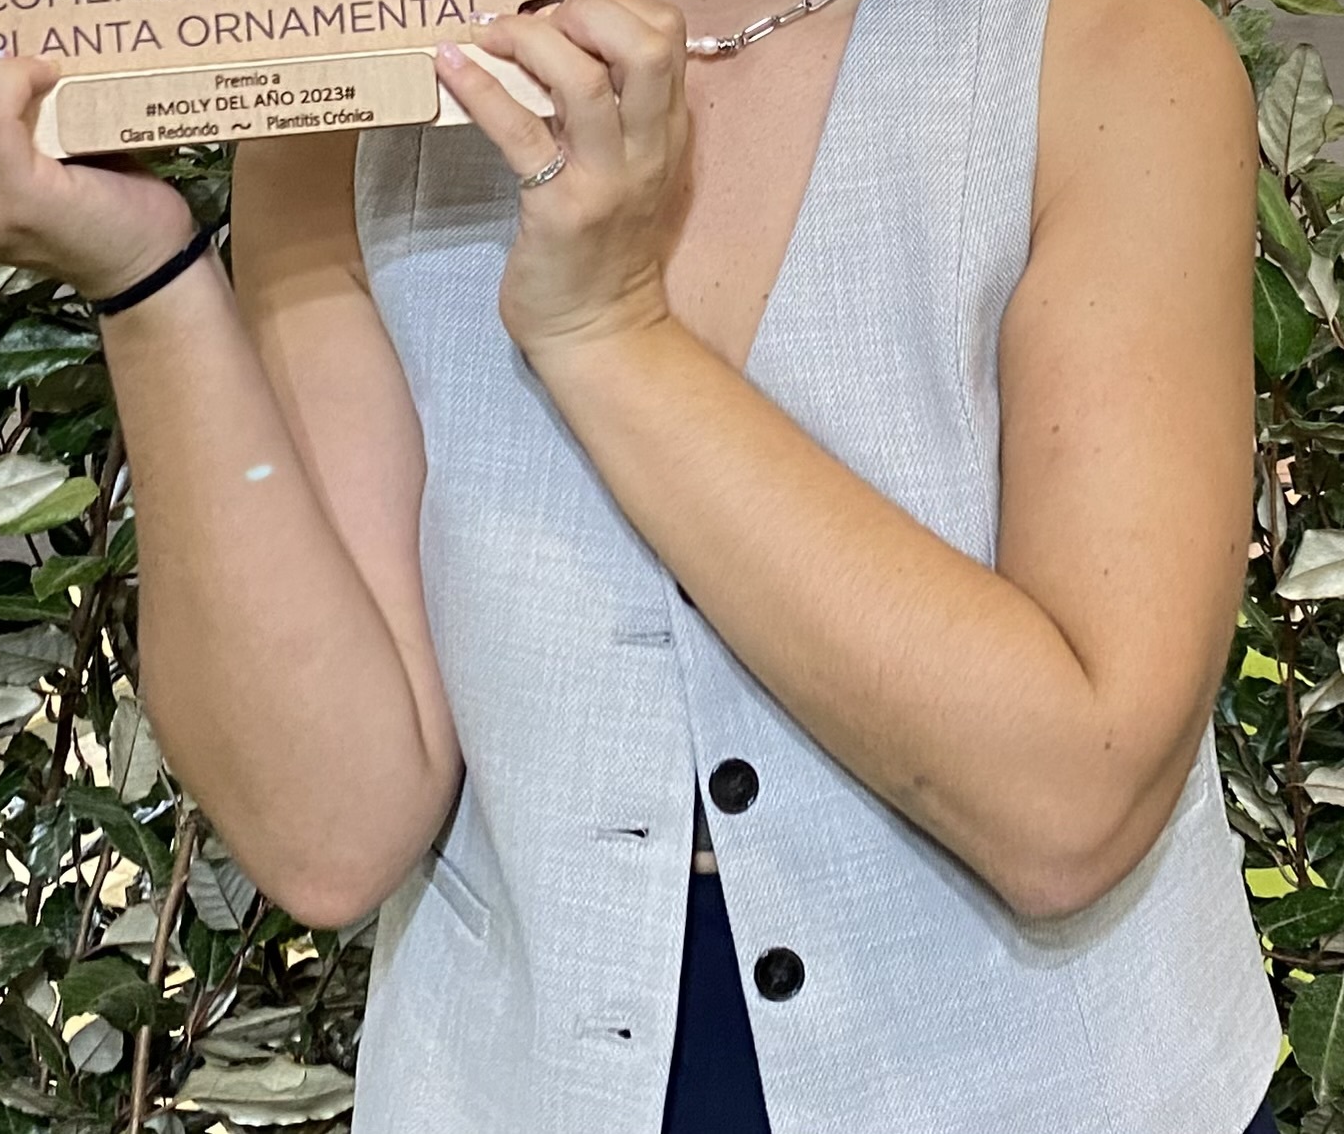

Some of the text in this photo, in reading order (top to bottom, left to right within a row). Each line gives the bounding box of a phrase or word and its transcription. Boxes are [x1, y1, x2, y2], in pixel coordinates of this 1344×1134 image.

[215, 72, 281, 90] Premio a
[146, 85, 355, 117] #MOLY DEL AÑO 2023#
[120, 128, 154, 143] Clara
[158, 122, 219, 140] Redondo
[267, 113, 321, 130] Plantitis
[323, 109, 374, 126] Crónica
